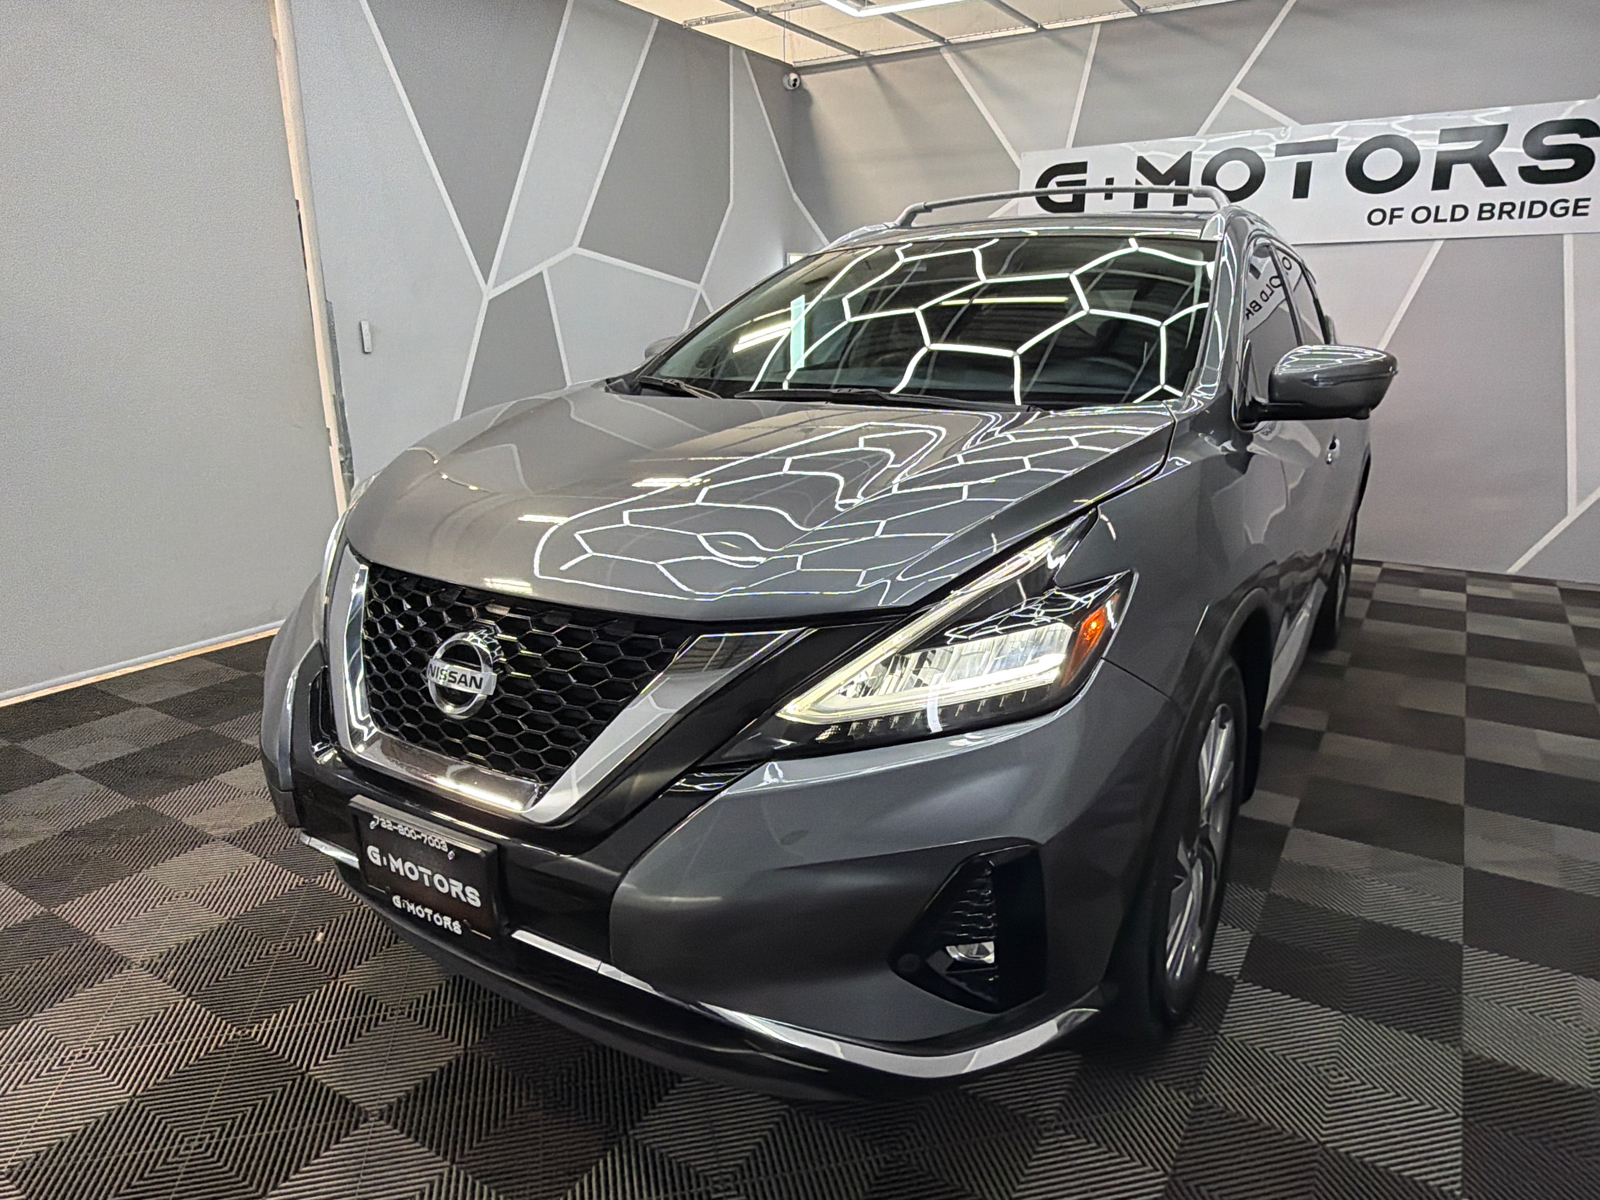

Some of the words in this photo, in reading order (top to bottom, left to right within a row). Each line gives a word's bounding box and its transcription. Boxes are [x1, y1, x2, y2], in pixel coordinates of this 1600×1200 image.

[1366, 207, 1404, 226] OF
[1411, 204, 1469, 224] OLD
[1477, 197, 1592, 221] BRIDGE
[427, 663, 484, 690] NISSAN
